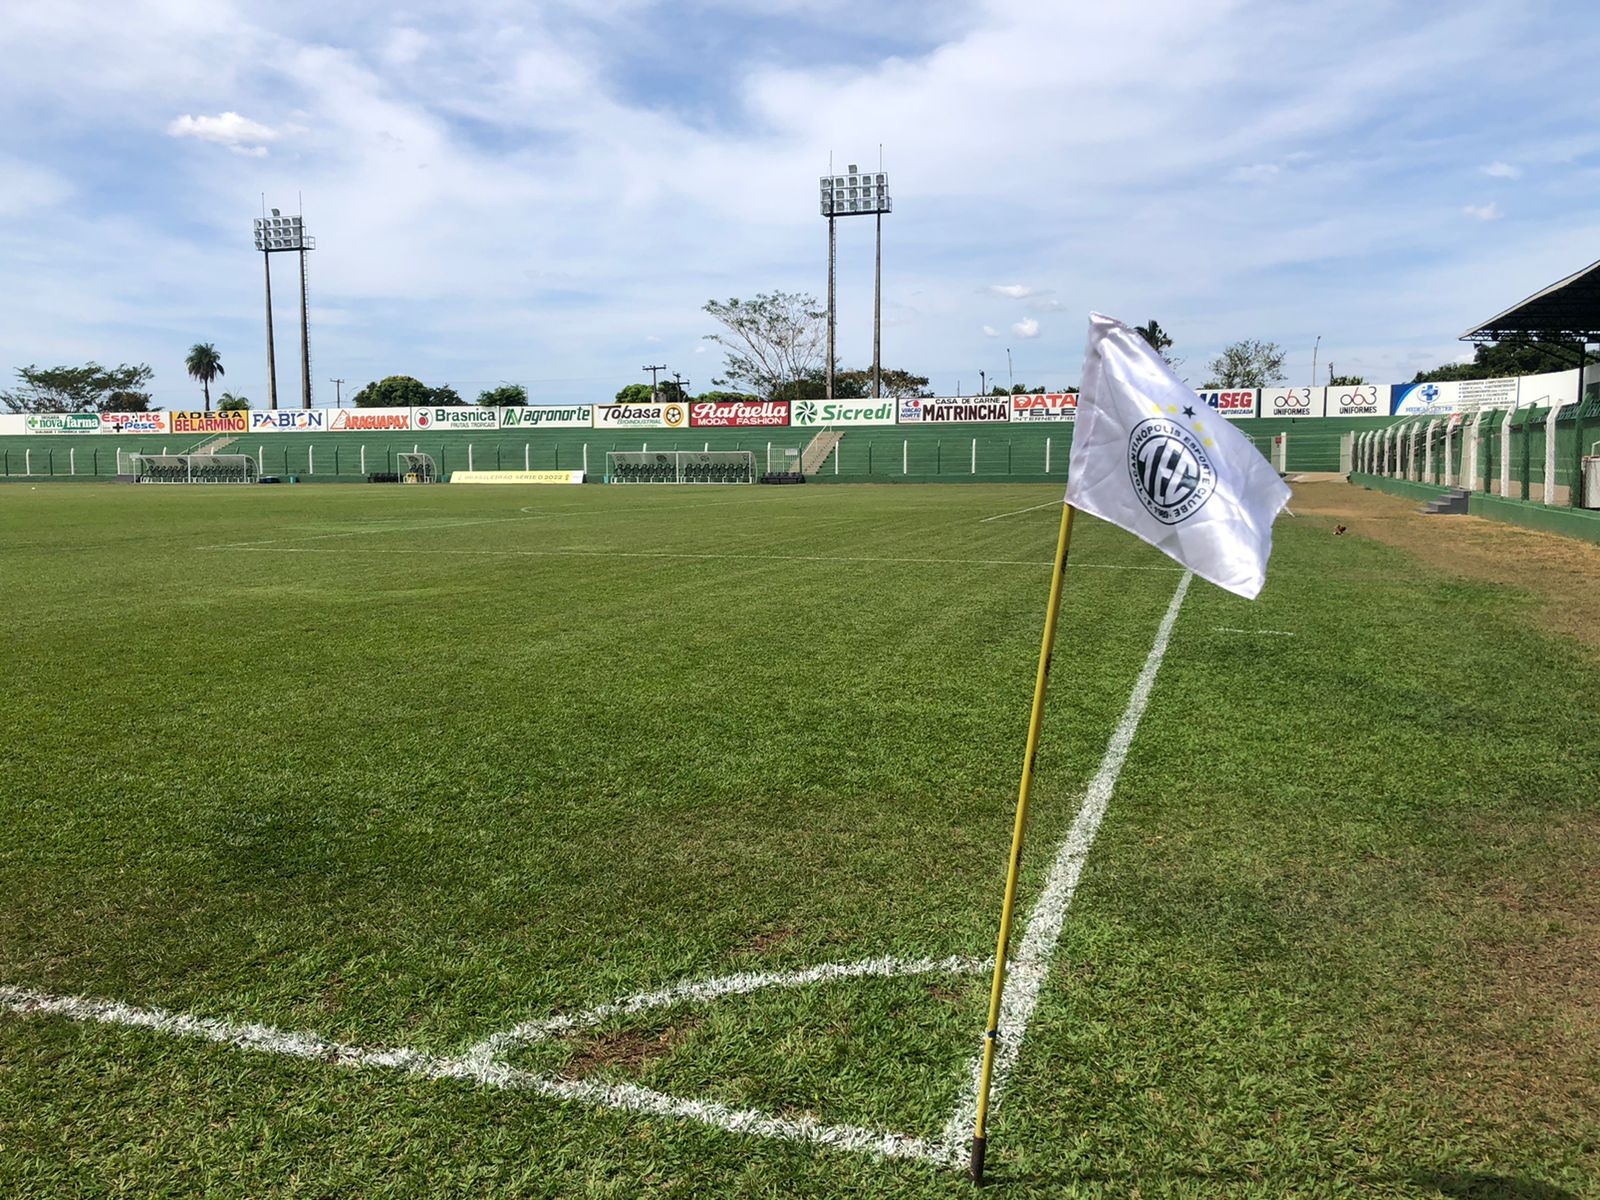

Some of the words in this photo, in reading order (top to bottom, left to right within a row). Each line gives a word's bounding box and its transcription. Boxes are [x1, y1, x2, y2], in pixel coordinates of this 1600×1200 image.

[1014, 394, 1078, 409] DATA
[177, 411, 242, 419] ADEGA
[435, 408, 496, 422] Brasnica
[524, 406, 590, 425] agronorte
[598, 405, 661, 421] Tobasa
[692, 402, 788, 418] Rafaella
[821, 403, 892, 420] Sicredi
[923, 401, 1008, 421] MATRINCHÃ
[1340, 406, 1377, 414] UNIFORMES
[40, 418, 63, 427] nova
[66, 415, 98, 427] farma
[175, 418, 245, 431] BELARMINO
[252, 412, 322, 427] FABION
[344, 415, 409, 430] ARAGUAPAX
[1183, 436, 1211, 484] ESPORTE
[1173, 487, 1207, 518] CLUBE
